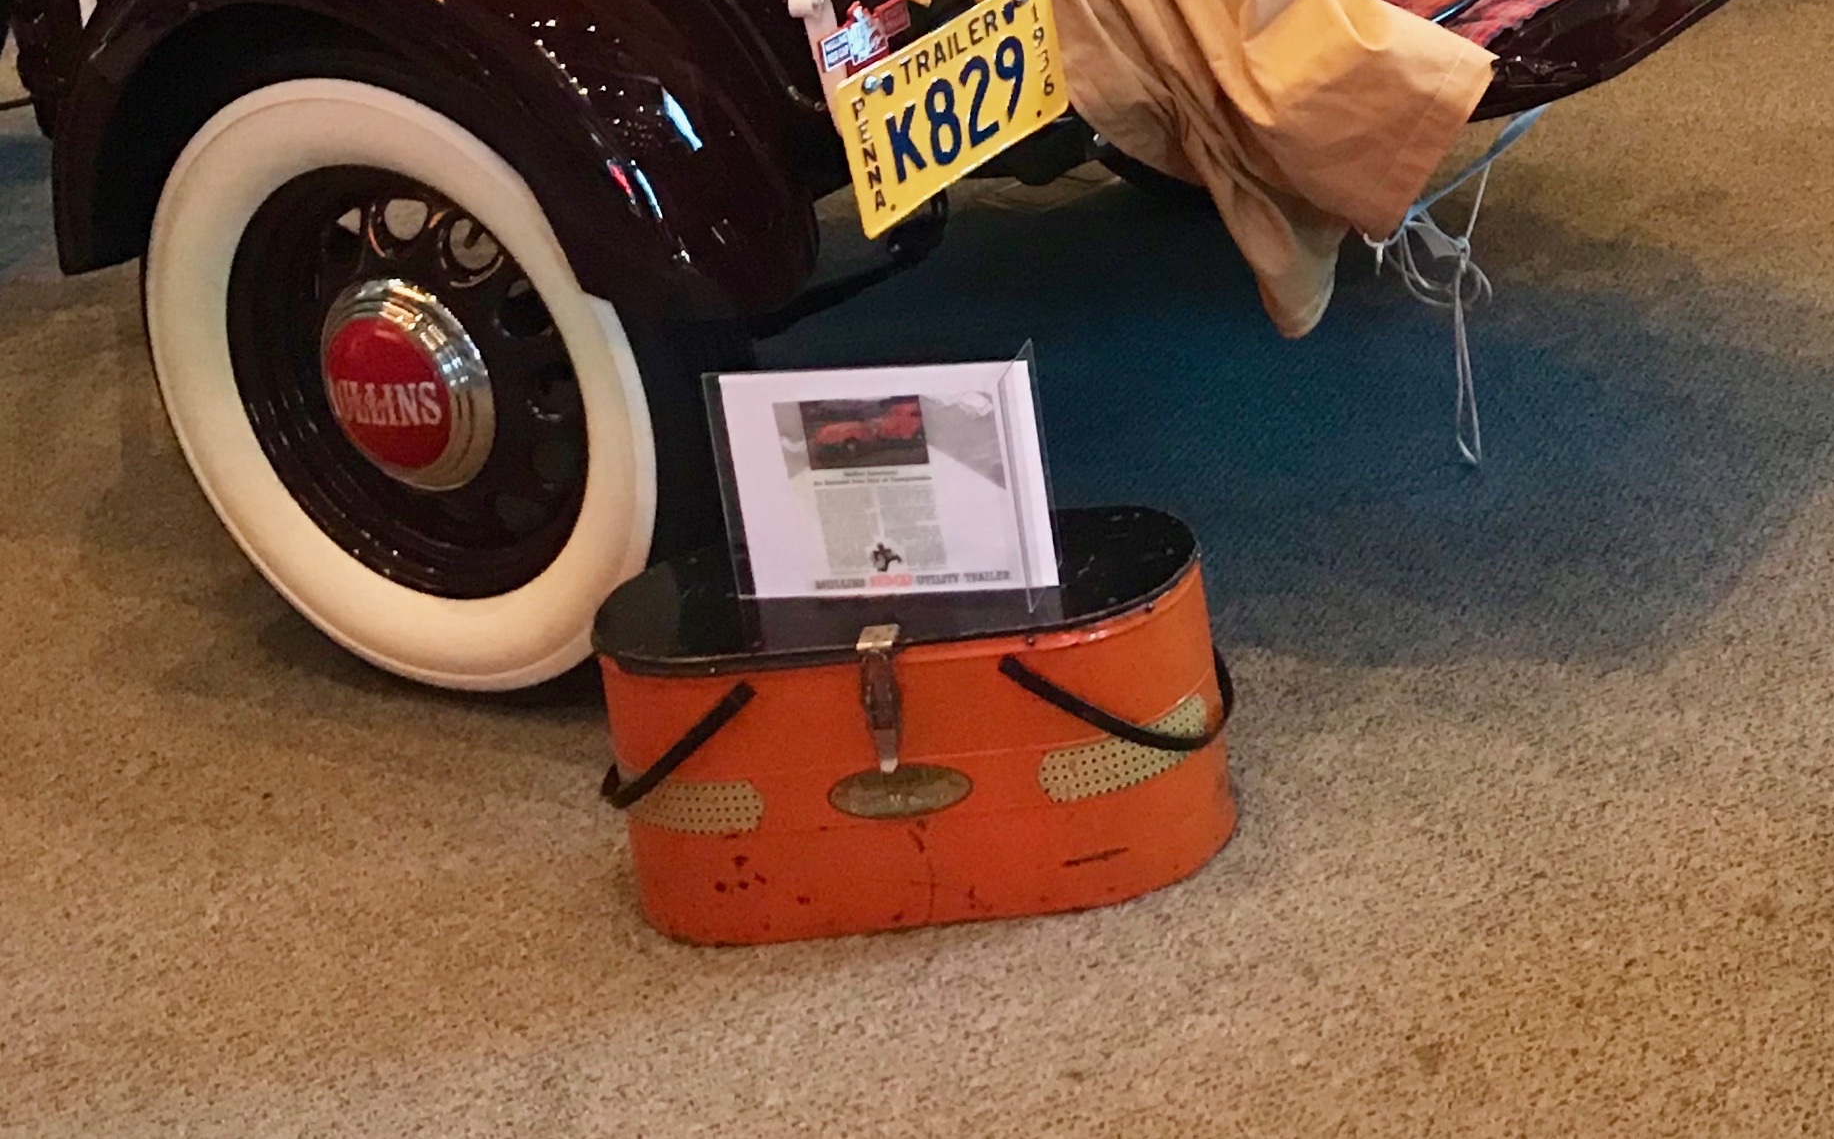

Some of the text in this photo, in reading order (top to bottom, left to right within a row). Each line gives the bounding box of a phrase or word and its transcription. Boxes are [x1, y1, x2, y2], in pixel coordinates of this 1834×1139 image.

[899, 8, 999, 85] TRAILER
[1031, 3, 1054, 97] 1936
[851, 97, 887, 212] PENNA
[884, 35, 1026, 185] K829
[916, 572, 959, 585] UTILITY
[963, 570, 1011, 583] TRAILER
